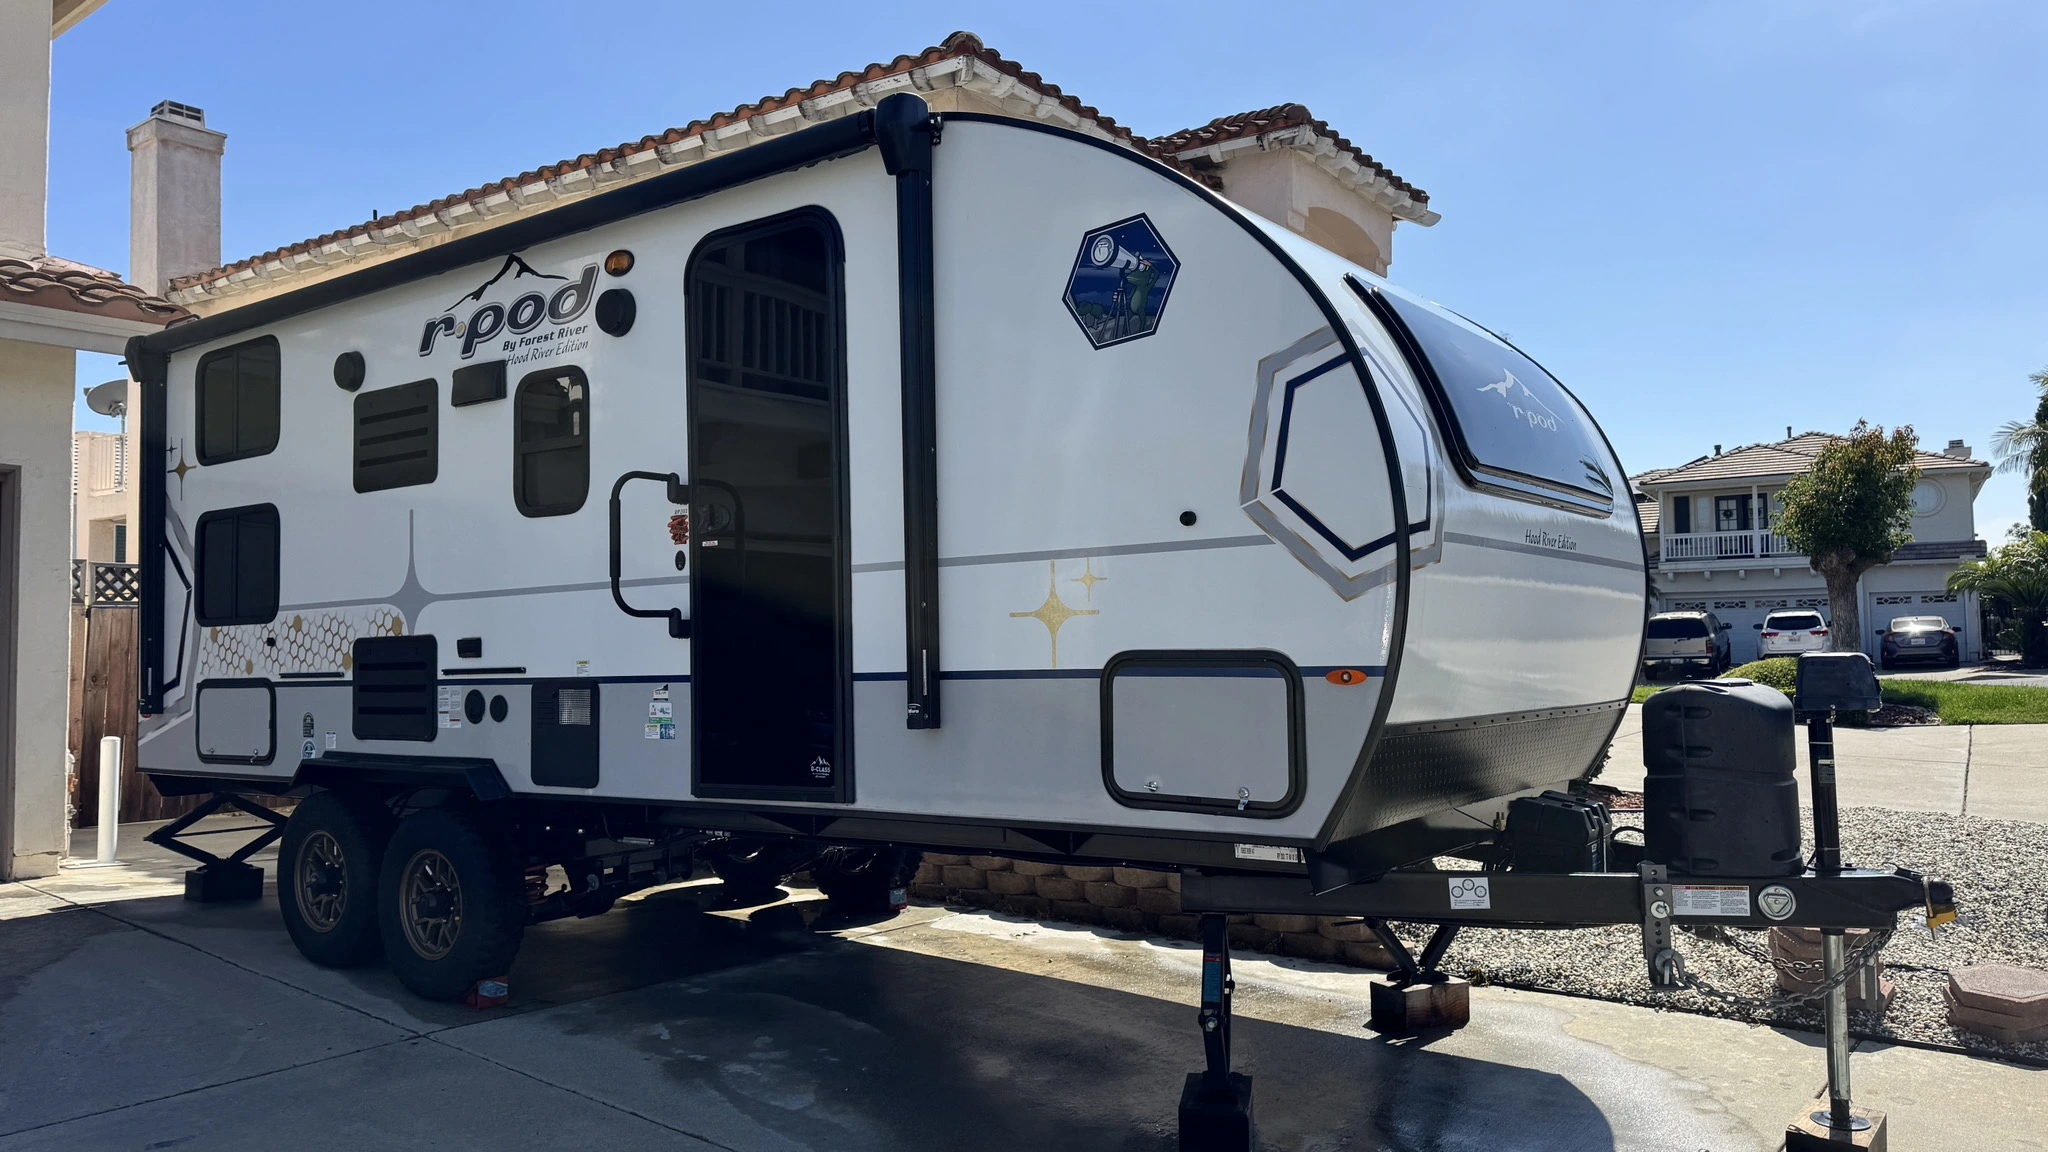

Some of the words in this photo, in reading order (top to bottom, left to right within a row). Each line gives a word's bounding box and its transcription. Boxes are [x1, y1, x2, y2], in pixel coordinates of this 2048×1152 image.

[503, 340, 517, 352] By
[519, 331, 555, 348] Forest
[557, 325, 588, 339] River
[506, 347, 531, 366] Hood
[530, 347, 554, 361] River
[555, 339, 589, 356] Edition
[1525, 528, 1542, 546] Hood
[1542, 531, 1557, 548] River
[1557, 533, 1577, 551] Edition
